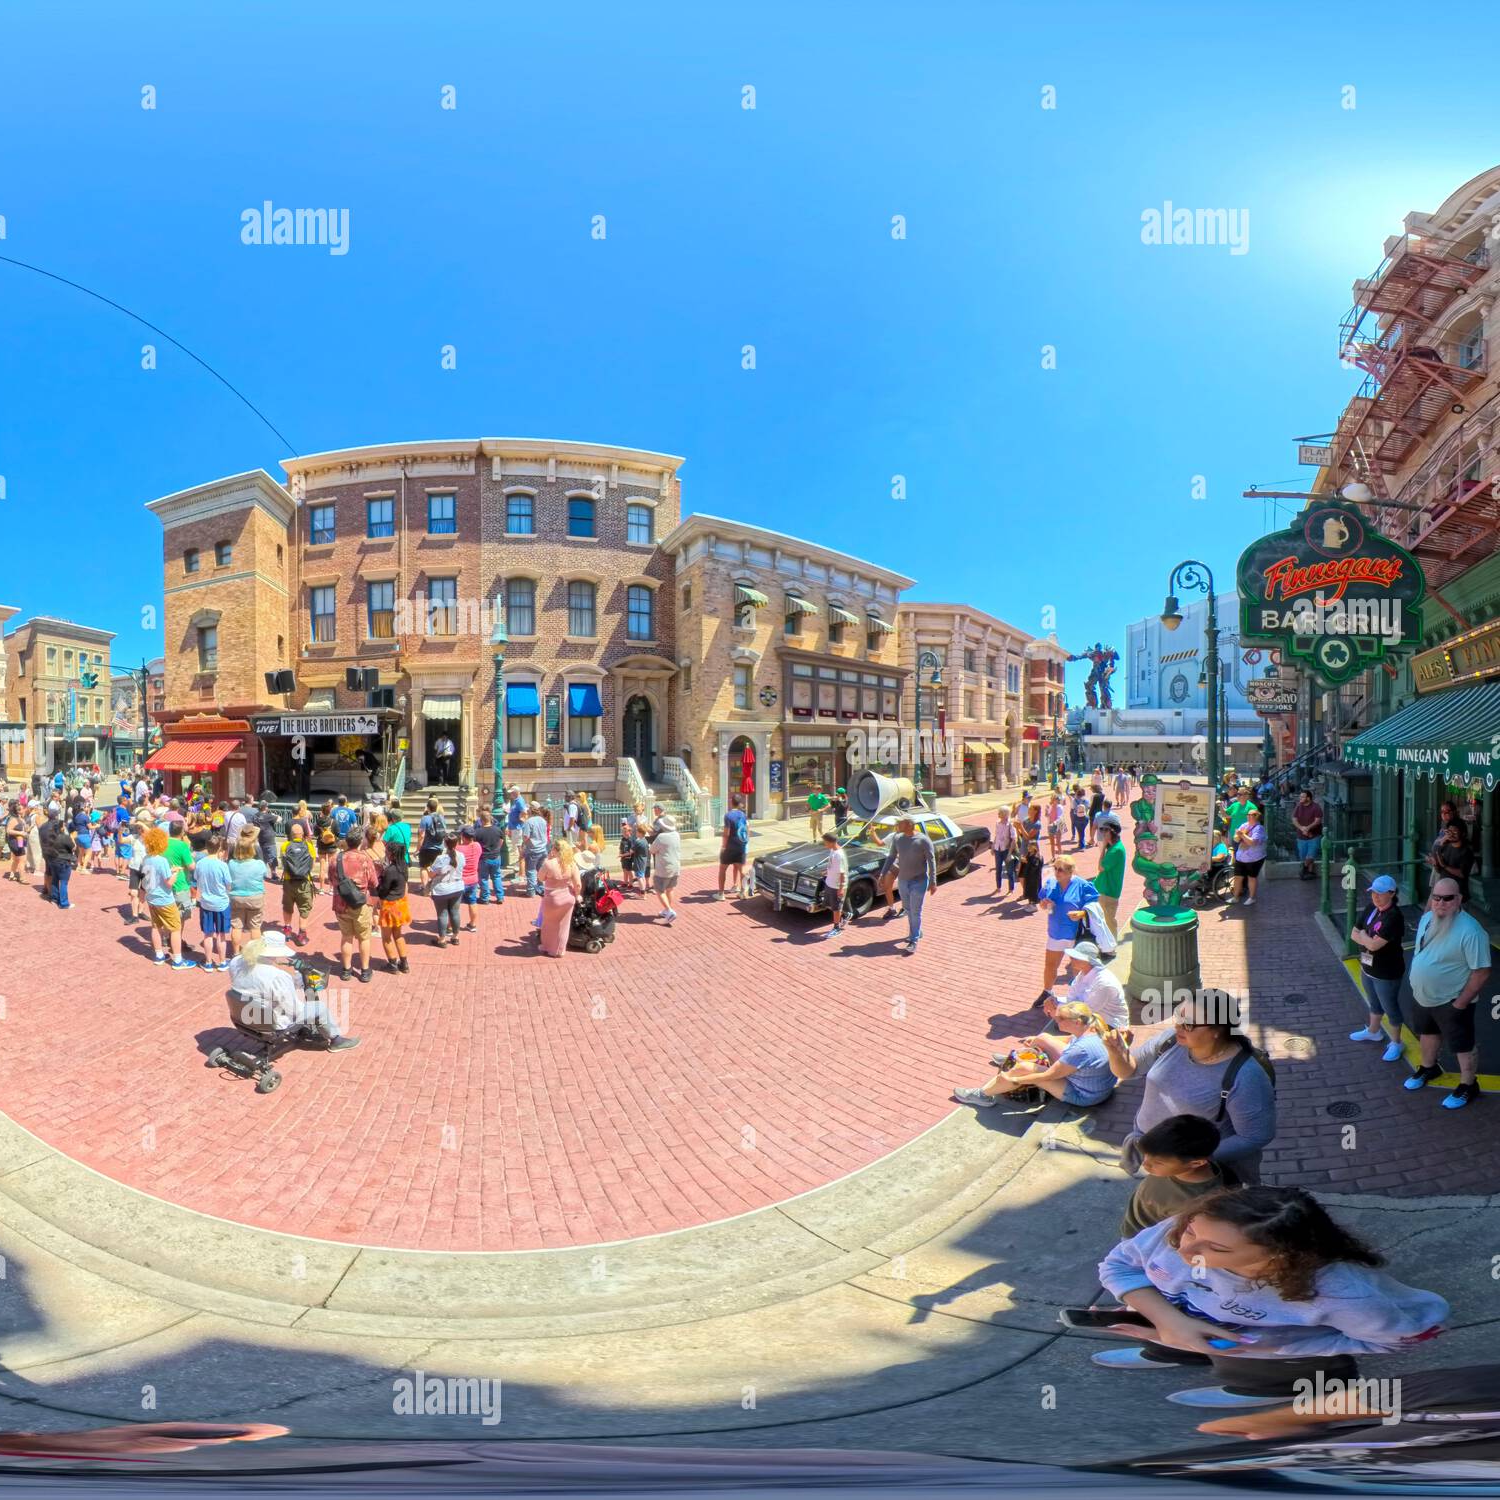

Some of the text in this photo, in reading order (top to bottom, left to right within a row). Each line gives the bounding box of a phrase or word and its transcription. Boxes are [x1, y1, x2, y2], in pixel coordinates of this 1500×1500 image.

[1304, 447, 1326, 456] FLAT
[1263, 555, 1403, 608] Finnegan's
[256, 725, 279, 733] LIVE!
[283, 718, 356, 733] THE BLUES BROTHERS
[1395, 749, 1449, 764] FINNEGAN'S
[1468, 752, 1491, 766] WINE
[1220, 1300, 1267, 1321] USA
